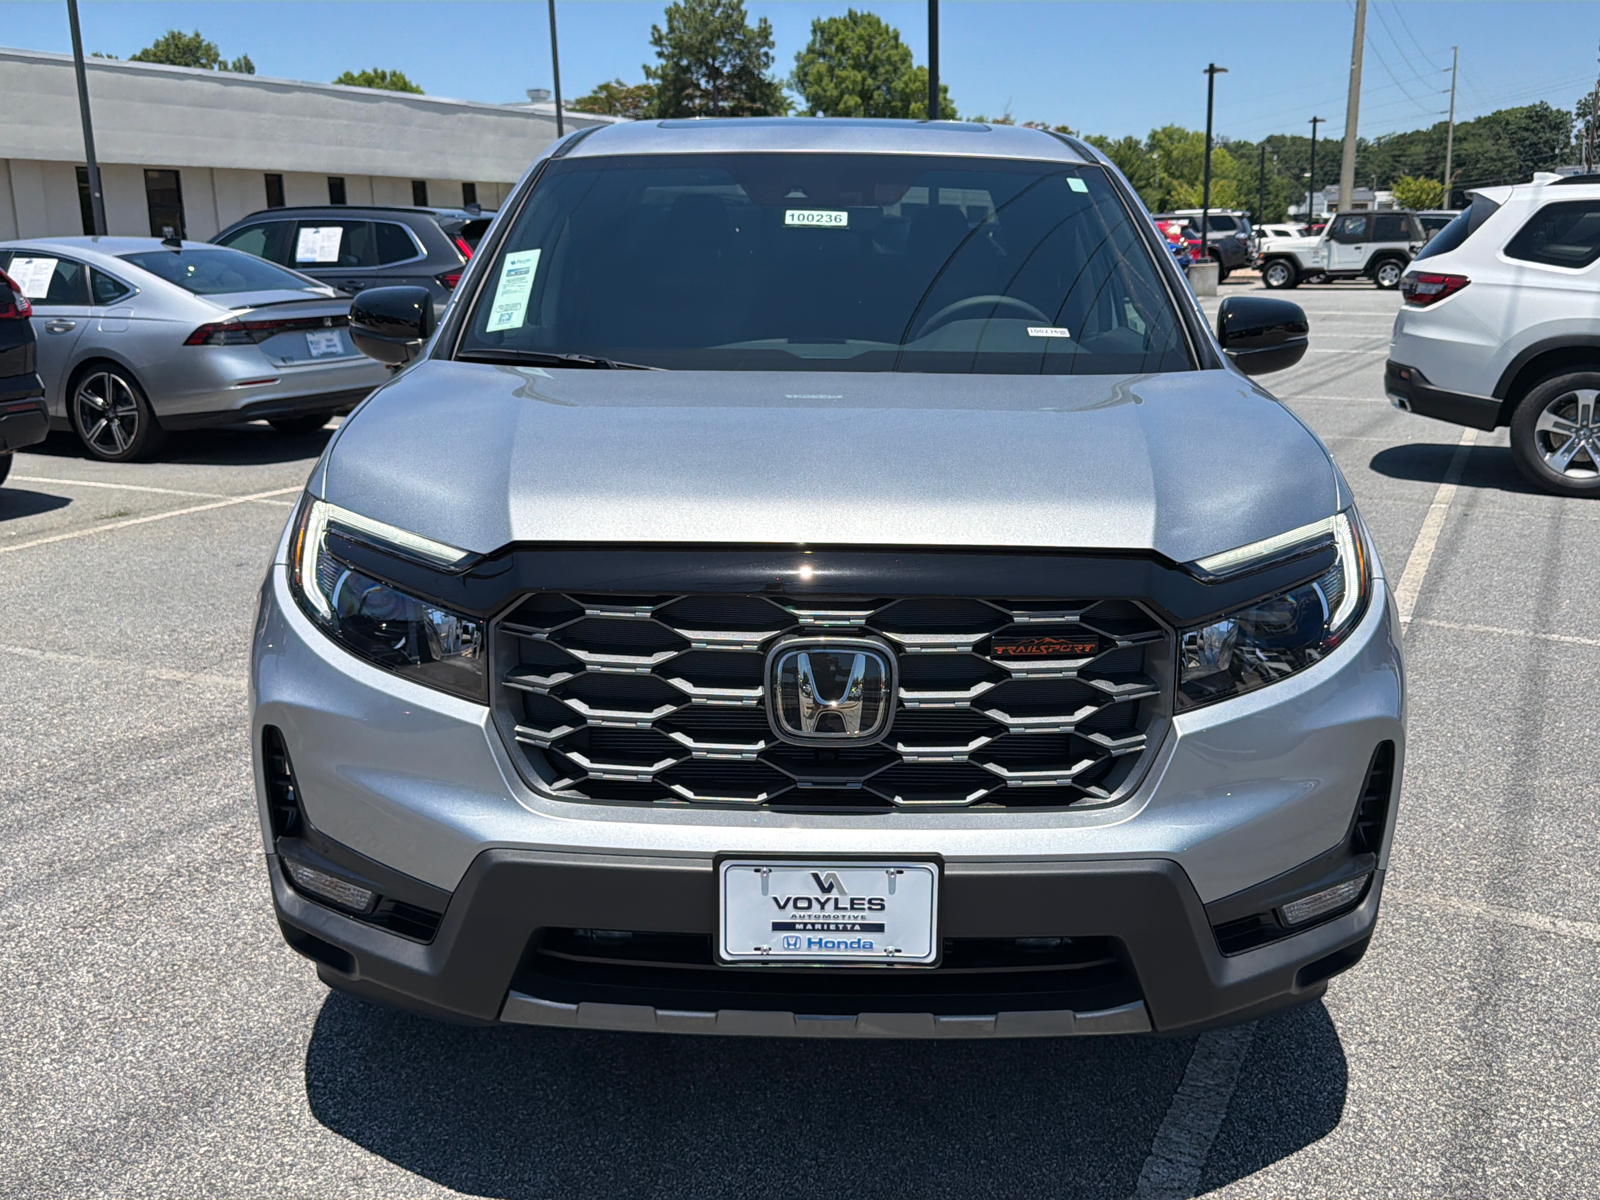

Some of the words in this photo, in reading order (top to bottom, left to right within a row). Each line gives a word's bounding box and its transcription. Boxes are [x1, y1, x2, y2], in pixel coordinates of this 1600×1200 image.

[788, 213, 843, 223] 100236
[994, 644, 1096, 655] TRAILSPORT
[772, 896, 886, 911] VOYLES
[795, 923, 861, 931] MARIETTA
[807, 937, 874, 950] Honda
